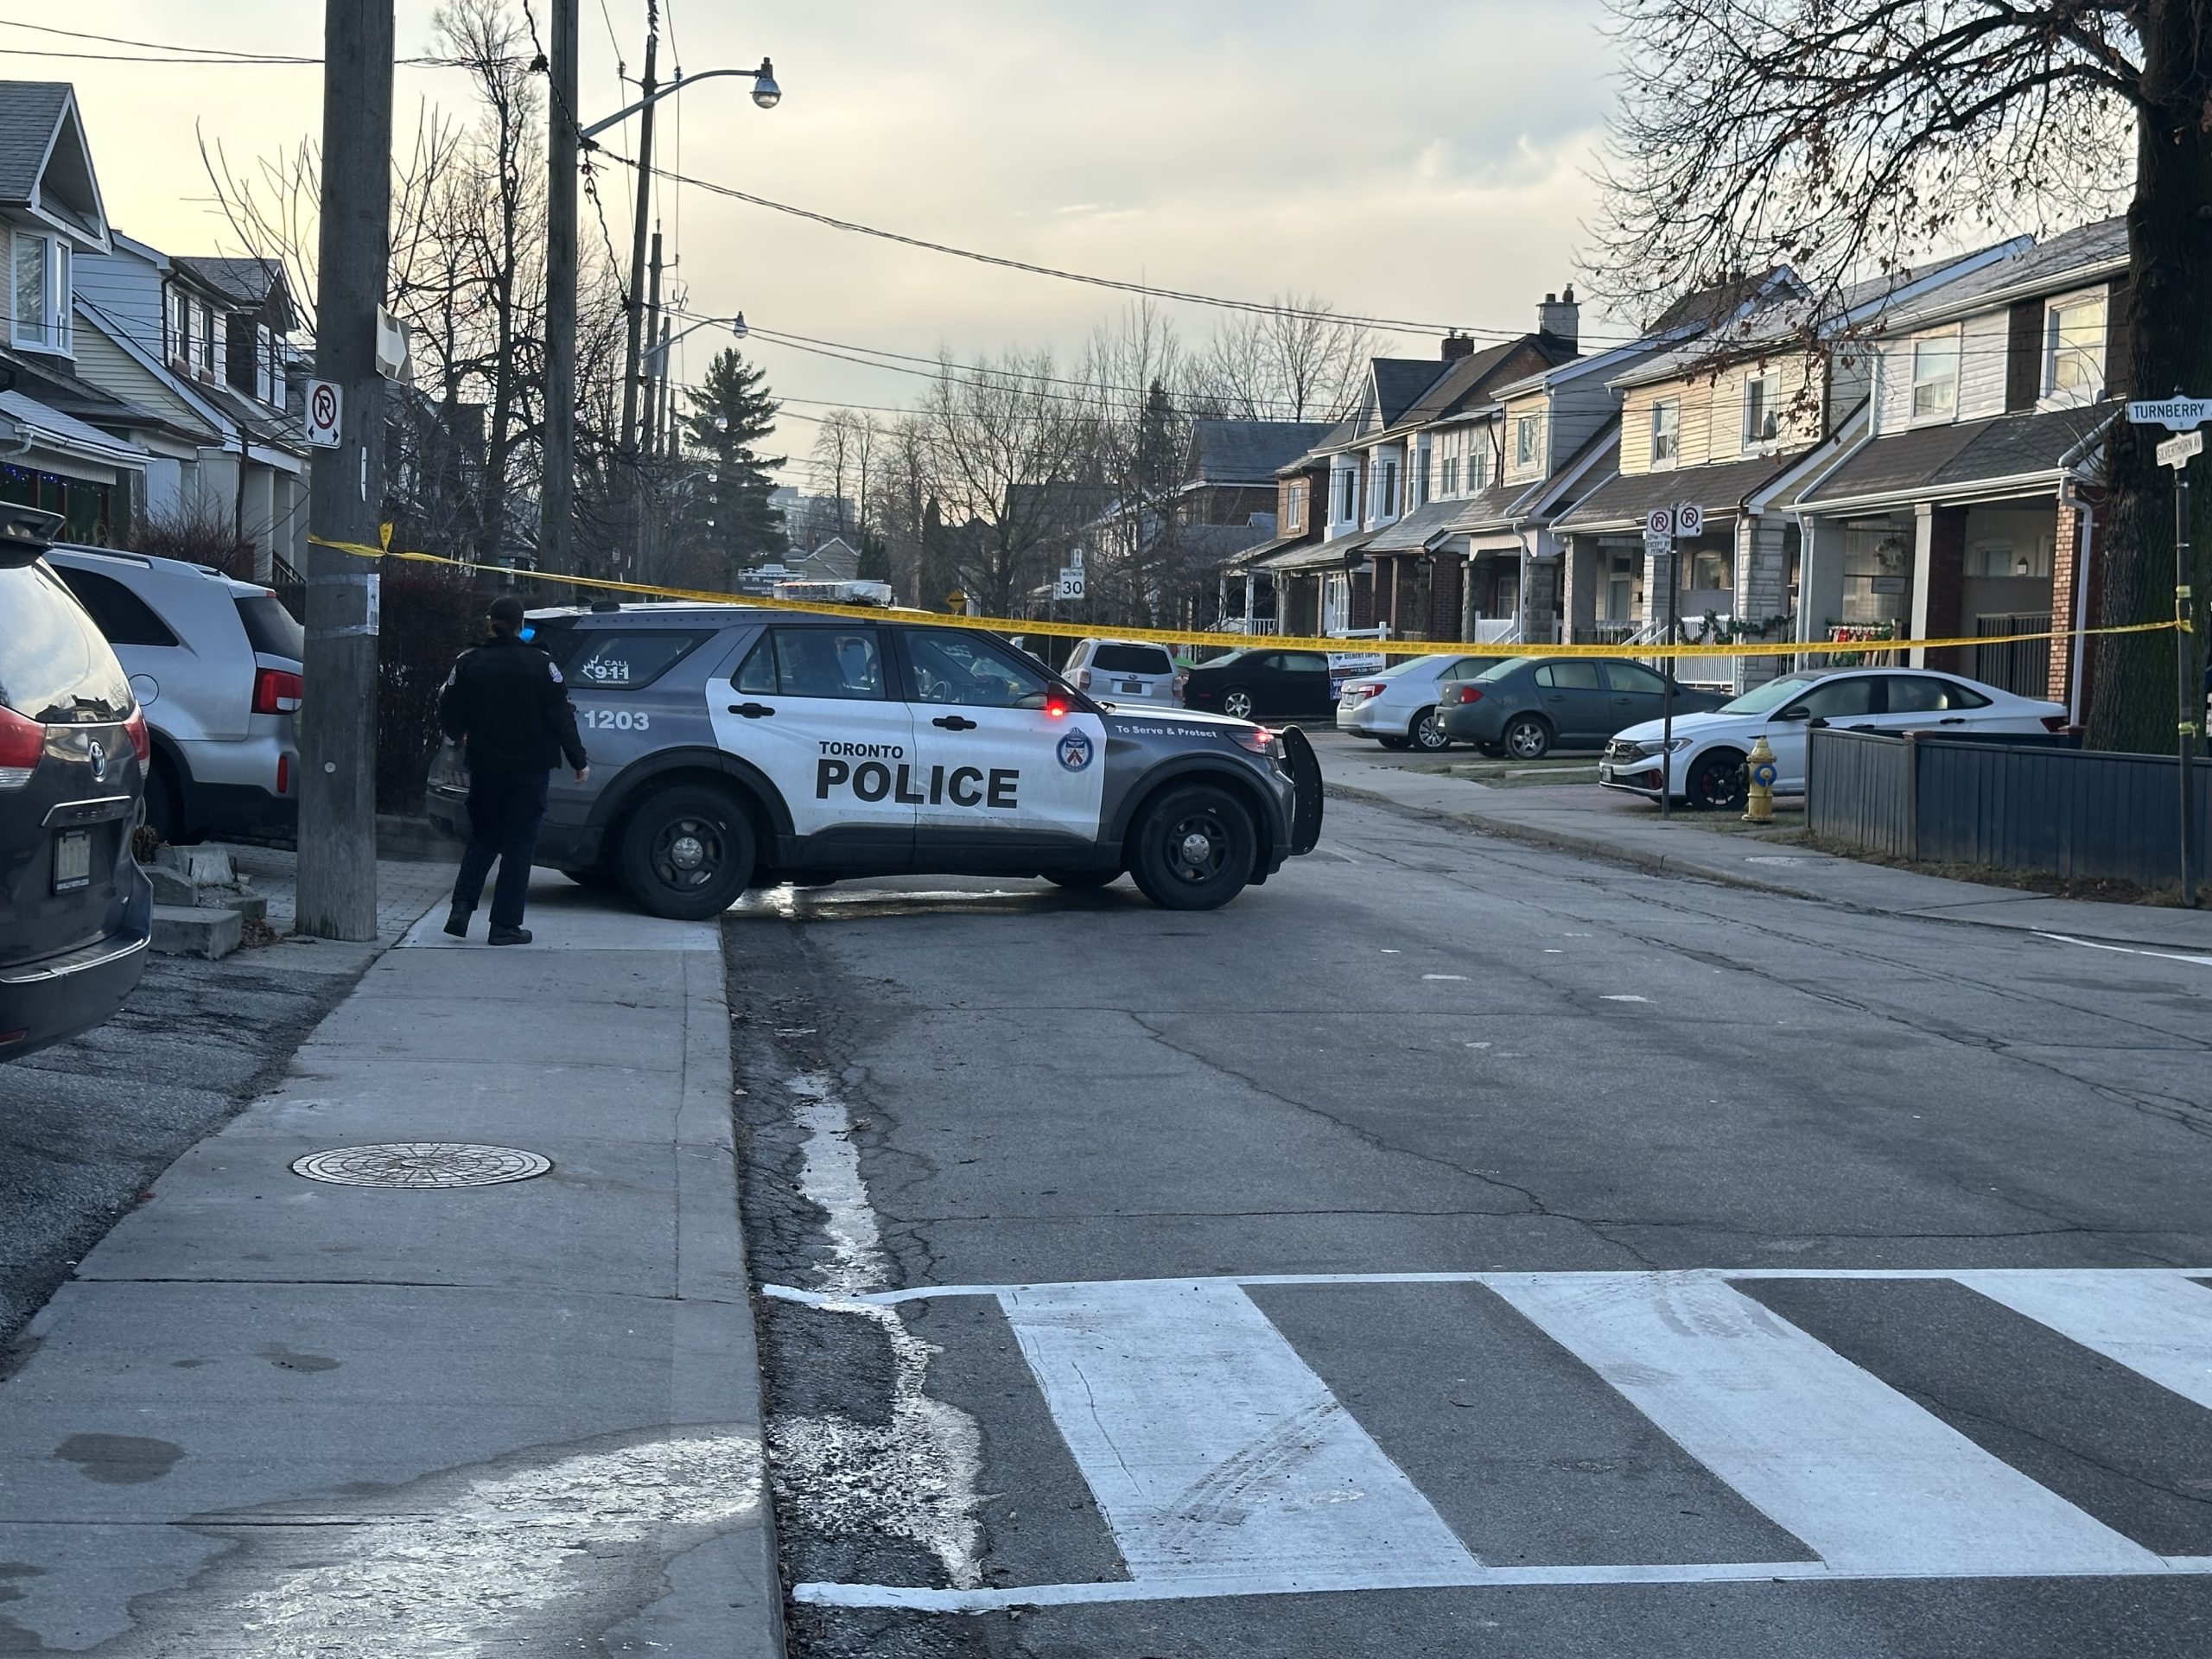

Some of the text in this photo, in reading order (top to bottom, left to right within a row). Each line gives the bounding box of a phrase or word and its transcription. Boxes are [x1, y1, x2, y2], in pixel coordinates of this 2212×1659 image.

[2133, 404, 2205, 419] TURNBERRY
[1062, 581, 1083, 594] 30
[594, 664, 629, 680] 9-1-1
[584, 710, 650, 731] 1203
[1116, 725, 1130, 734] To
[1133, 726, 1163, 734] Serve
[1178, 728, 1217, 738] Protect
[819, 741, 904, 759] TORONTO
[816, 759, 1020, 809] POLICE
